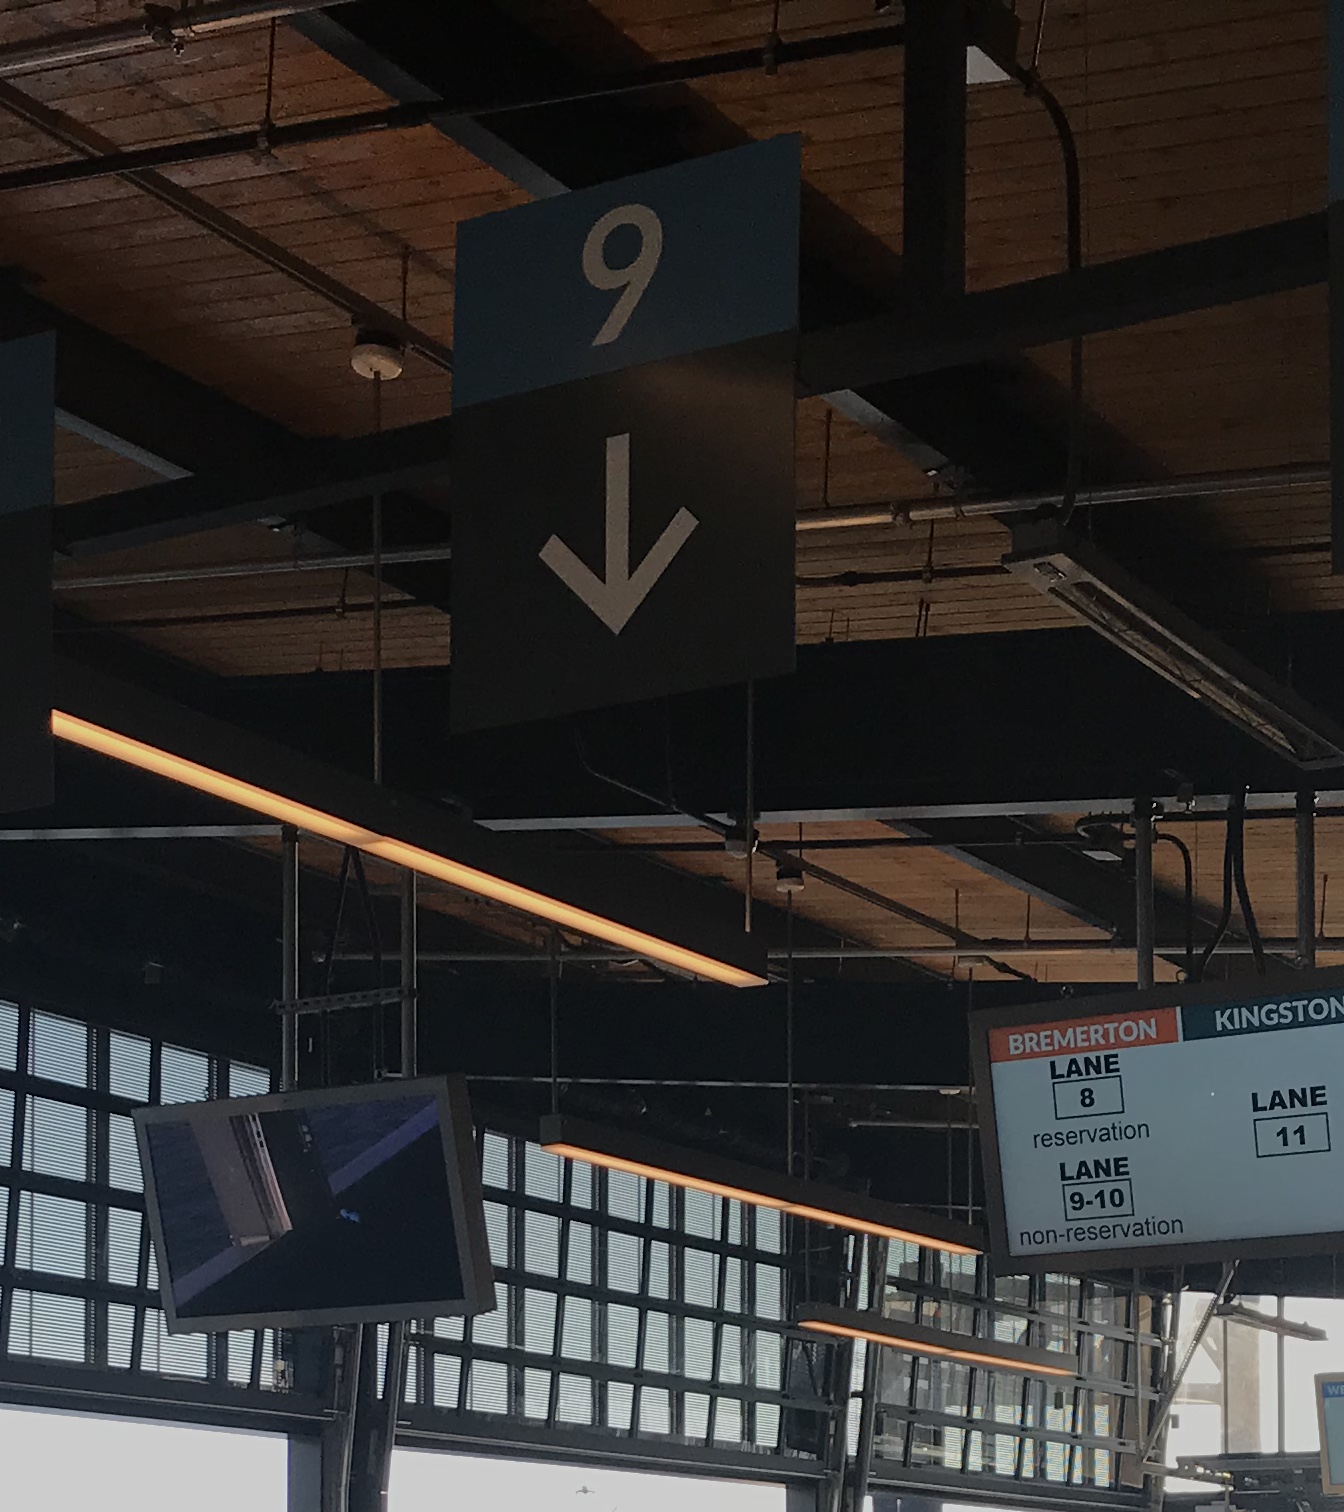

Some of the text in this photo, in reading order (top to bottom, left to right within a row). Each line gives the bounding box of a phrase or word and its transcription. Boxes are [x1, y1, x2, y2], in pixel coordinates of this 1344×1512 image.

[579, 202, 665, 349] 9
[1008, 1017, 1158, 1056] BREMERTON
[1050, 1053, 1121, 1081] LANE
[1080, 1088, 1095, 1109] 8
[1252, 1085, 1328, 1113] LANE
[1032, 1120, 1150, 1149] reservation
[1275, 1124, 1307, 1149] 11
[1059, 1156, 1130, 1182] LANE
[1069, 1188, 1126, 1212] 9-10
[1019, 1216, 1184, 1246] non-reservation
